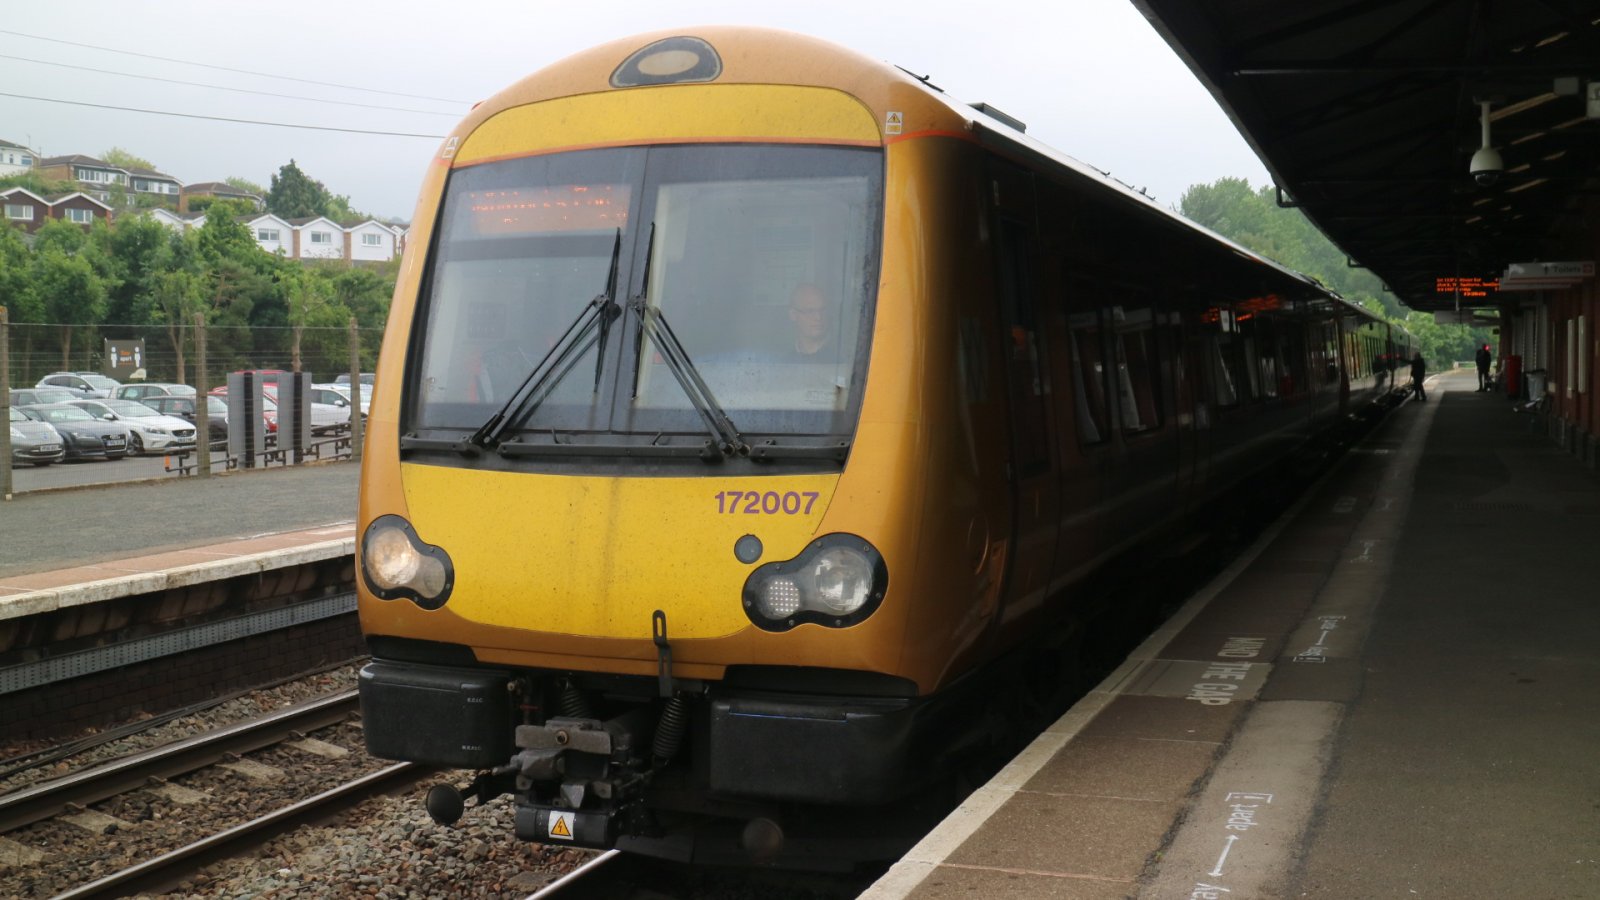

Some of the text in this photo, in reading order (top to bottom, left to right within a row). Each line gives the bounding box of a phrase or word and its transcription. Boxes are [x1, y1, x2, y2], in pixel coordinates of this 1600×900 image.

[715, 491, 819, 515] 172007
[1185, 637, 1266, 706] MIND THE GAP
[1190, 803, 1260, 900] ay apart
